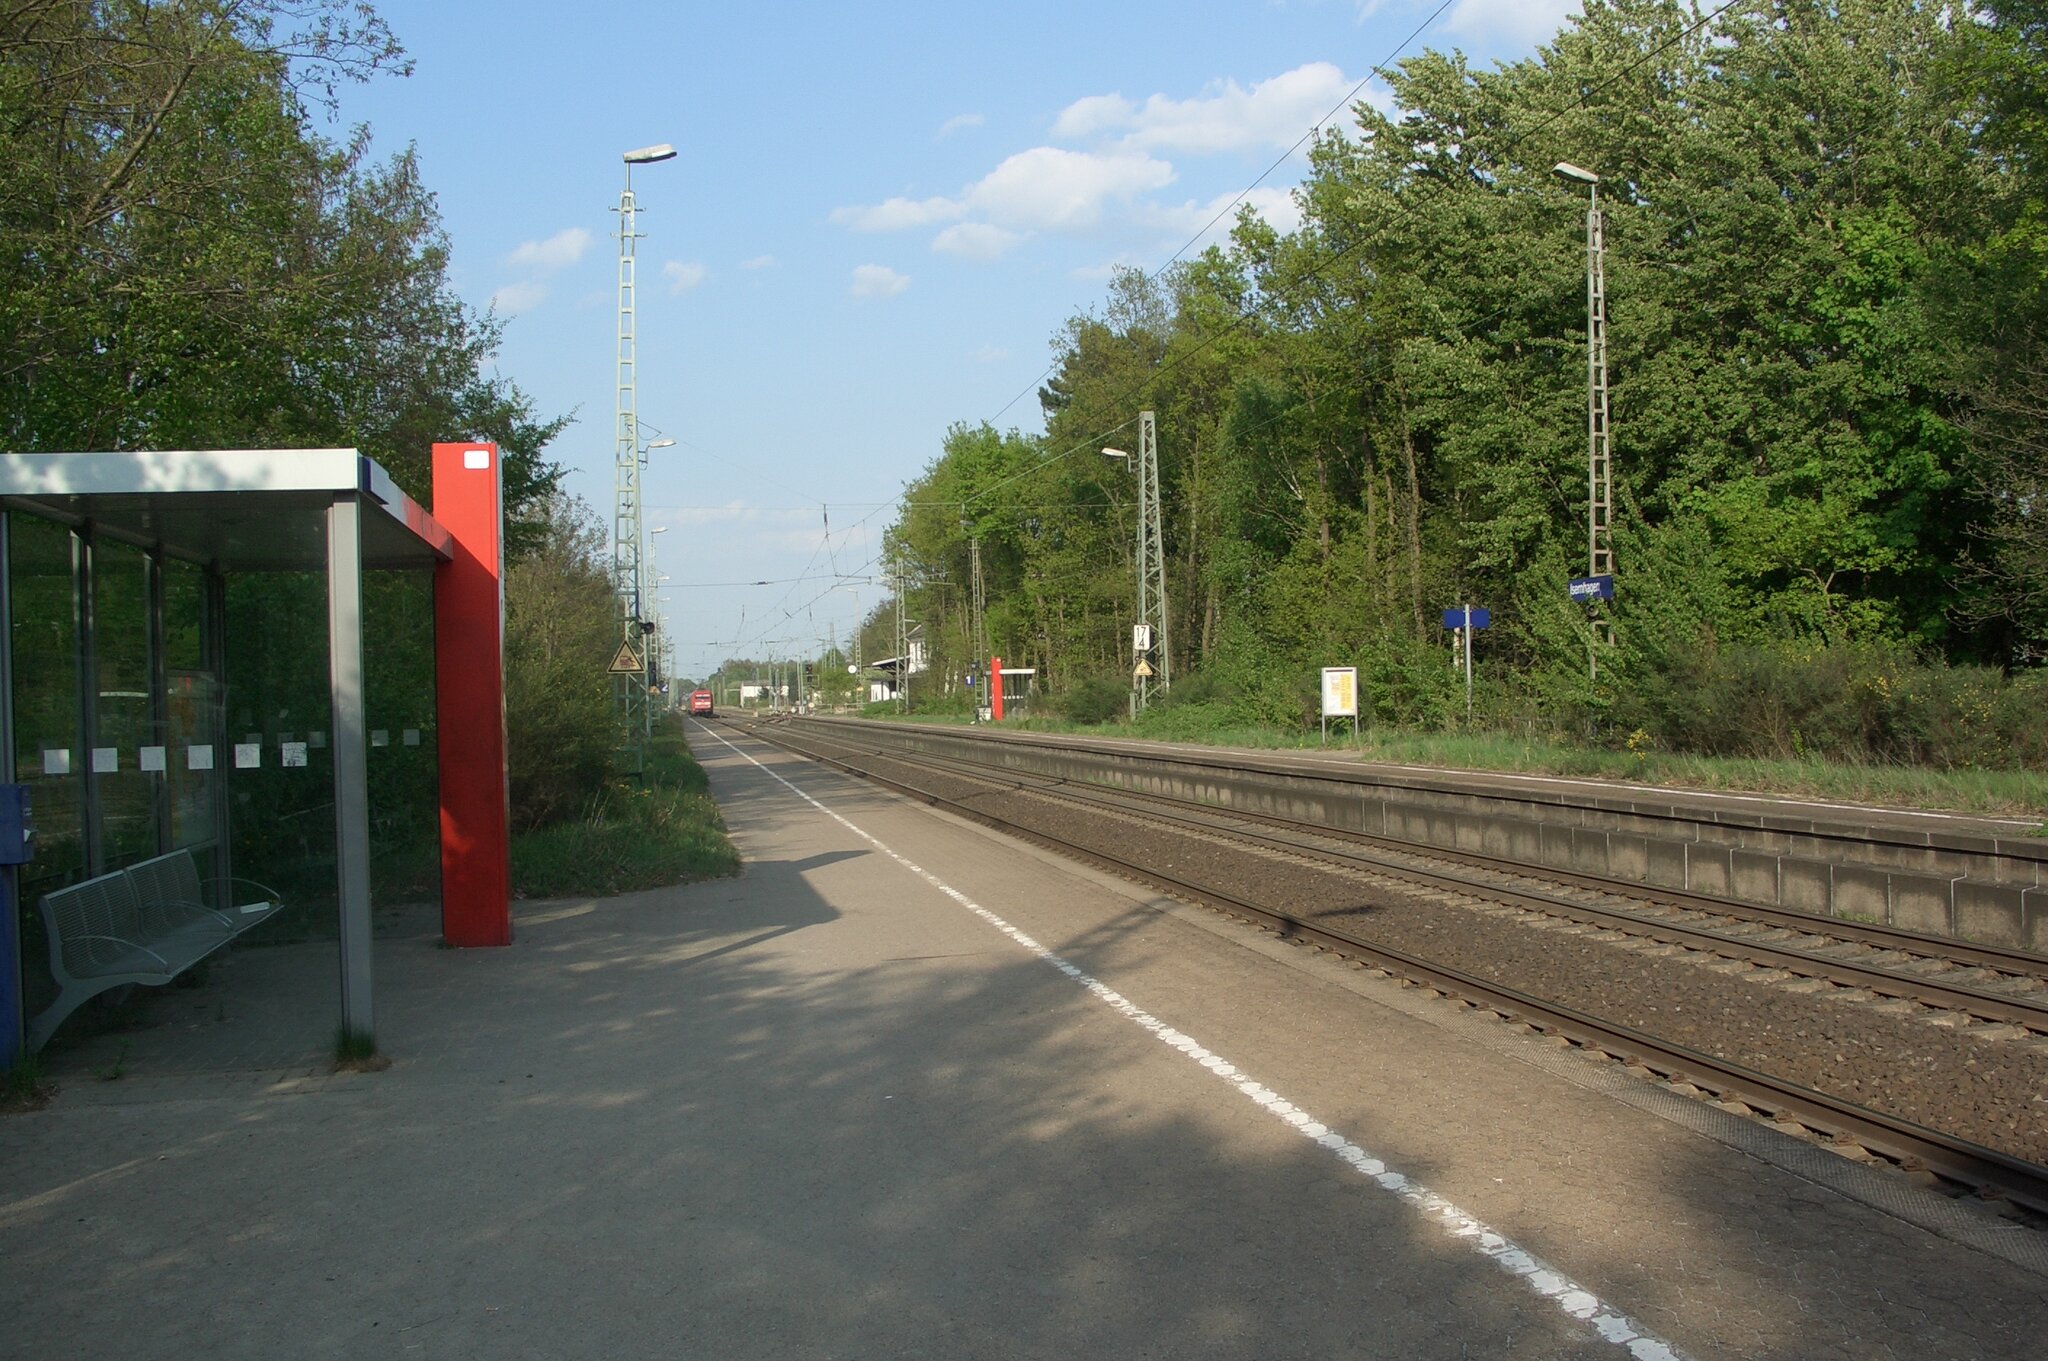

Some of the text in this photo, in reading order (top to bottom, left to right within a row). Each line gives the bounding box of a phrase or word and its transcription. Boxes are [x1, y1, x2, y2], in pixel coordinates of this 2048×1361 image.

[1136, 627, 1146, 638] 17
[1138, 638, 1145, 649] 4
[965, 675, 971, 685] 1
